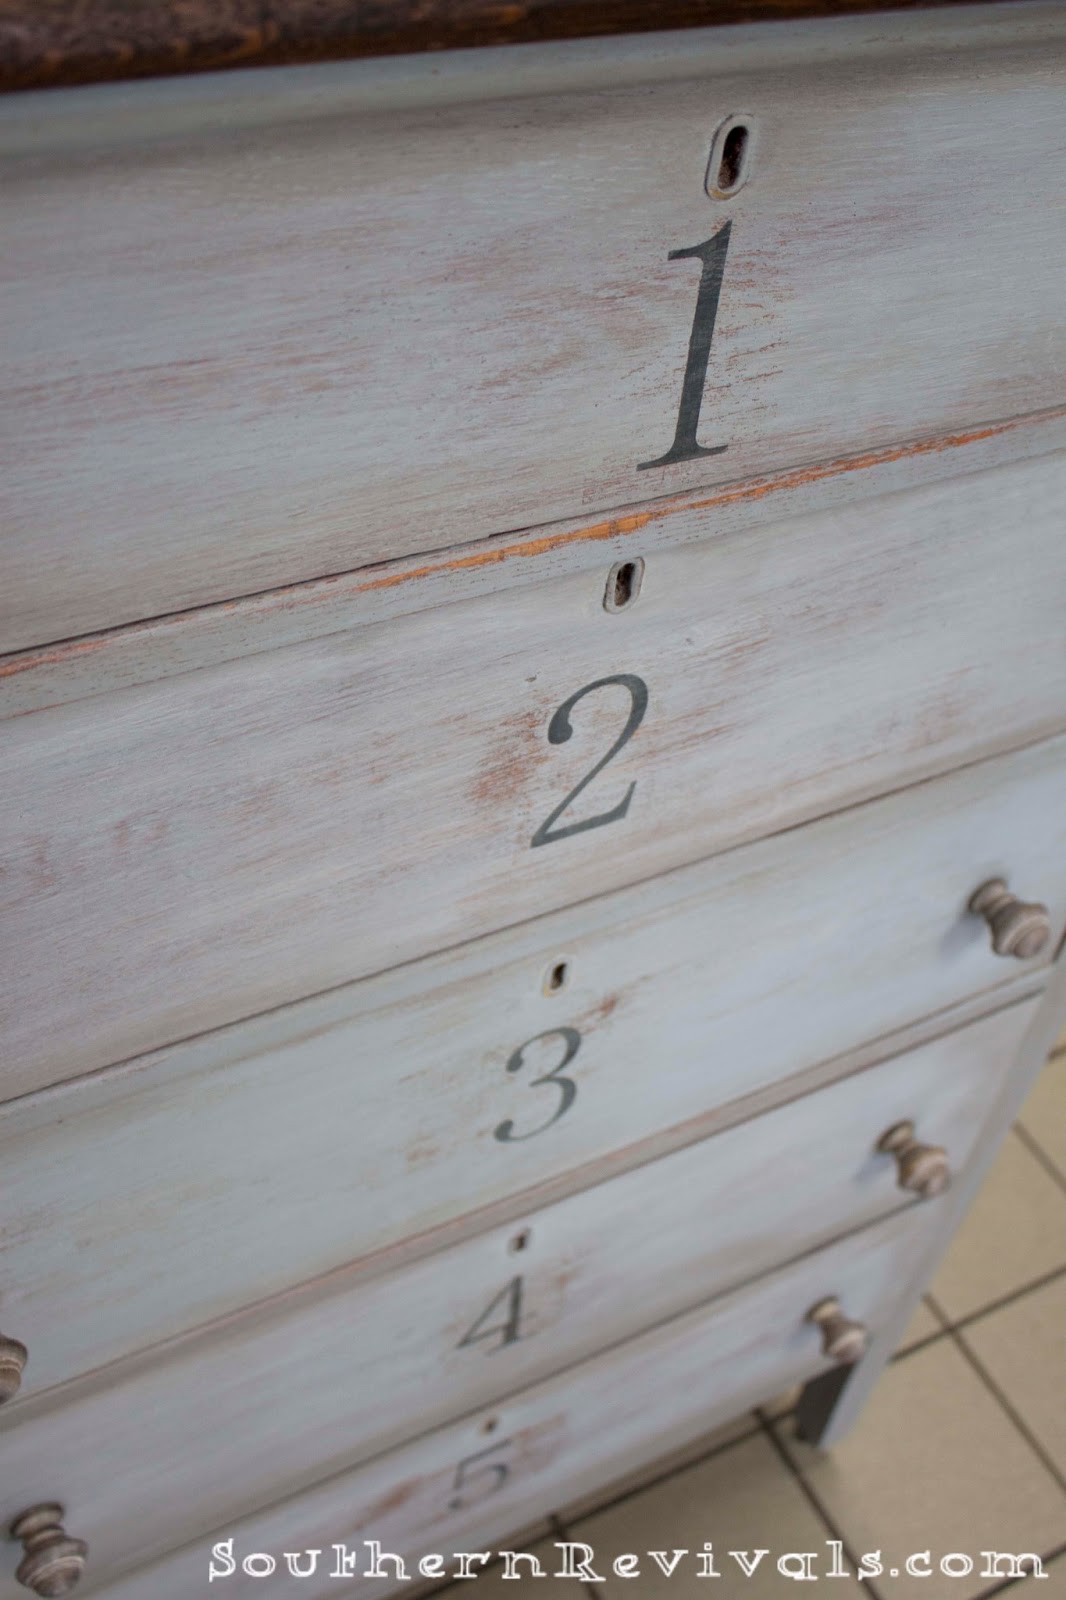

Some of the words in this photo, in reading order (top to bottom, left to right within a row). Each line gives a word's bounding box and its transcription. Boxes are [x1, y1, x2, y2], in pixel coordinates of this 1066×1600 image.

[637, 220, 732, 472] 1
[532, 674, 649, 848] 2
[495, 1027, 582, 1142] 3
[457, 1275, 523, 1356] 4
[447, 1439, 511, 1512] 5
